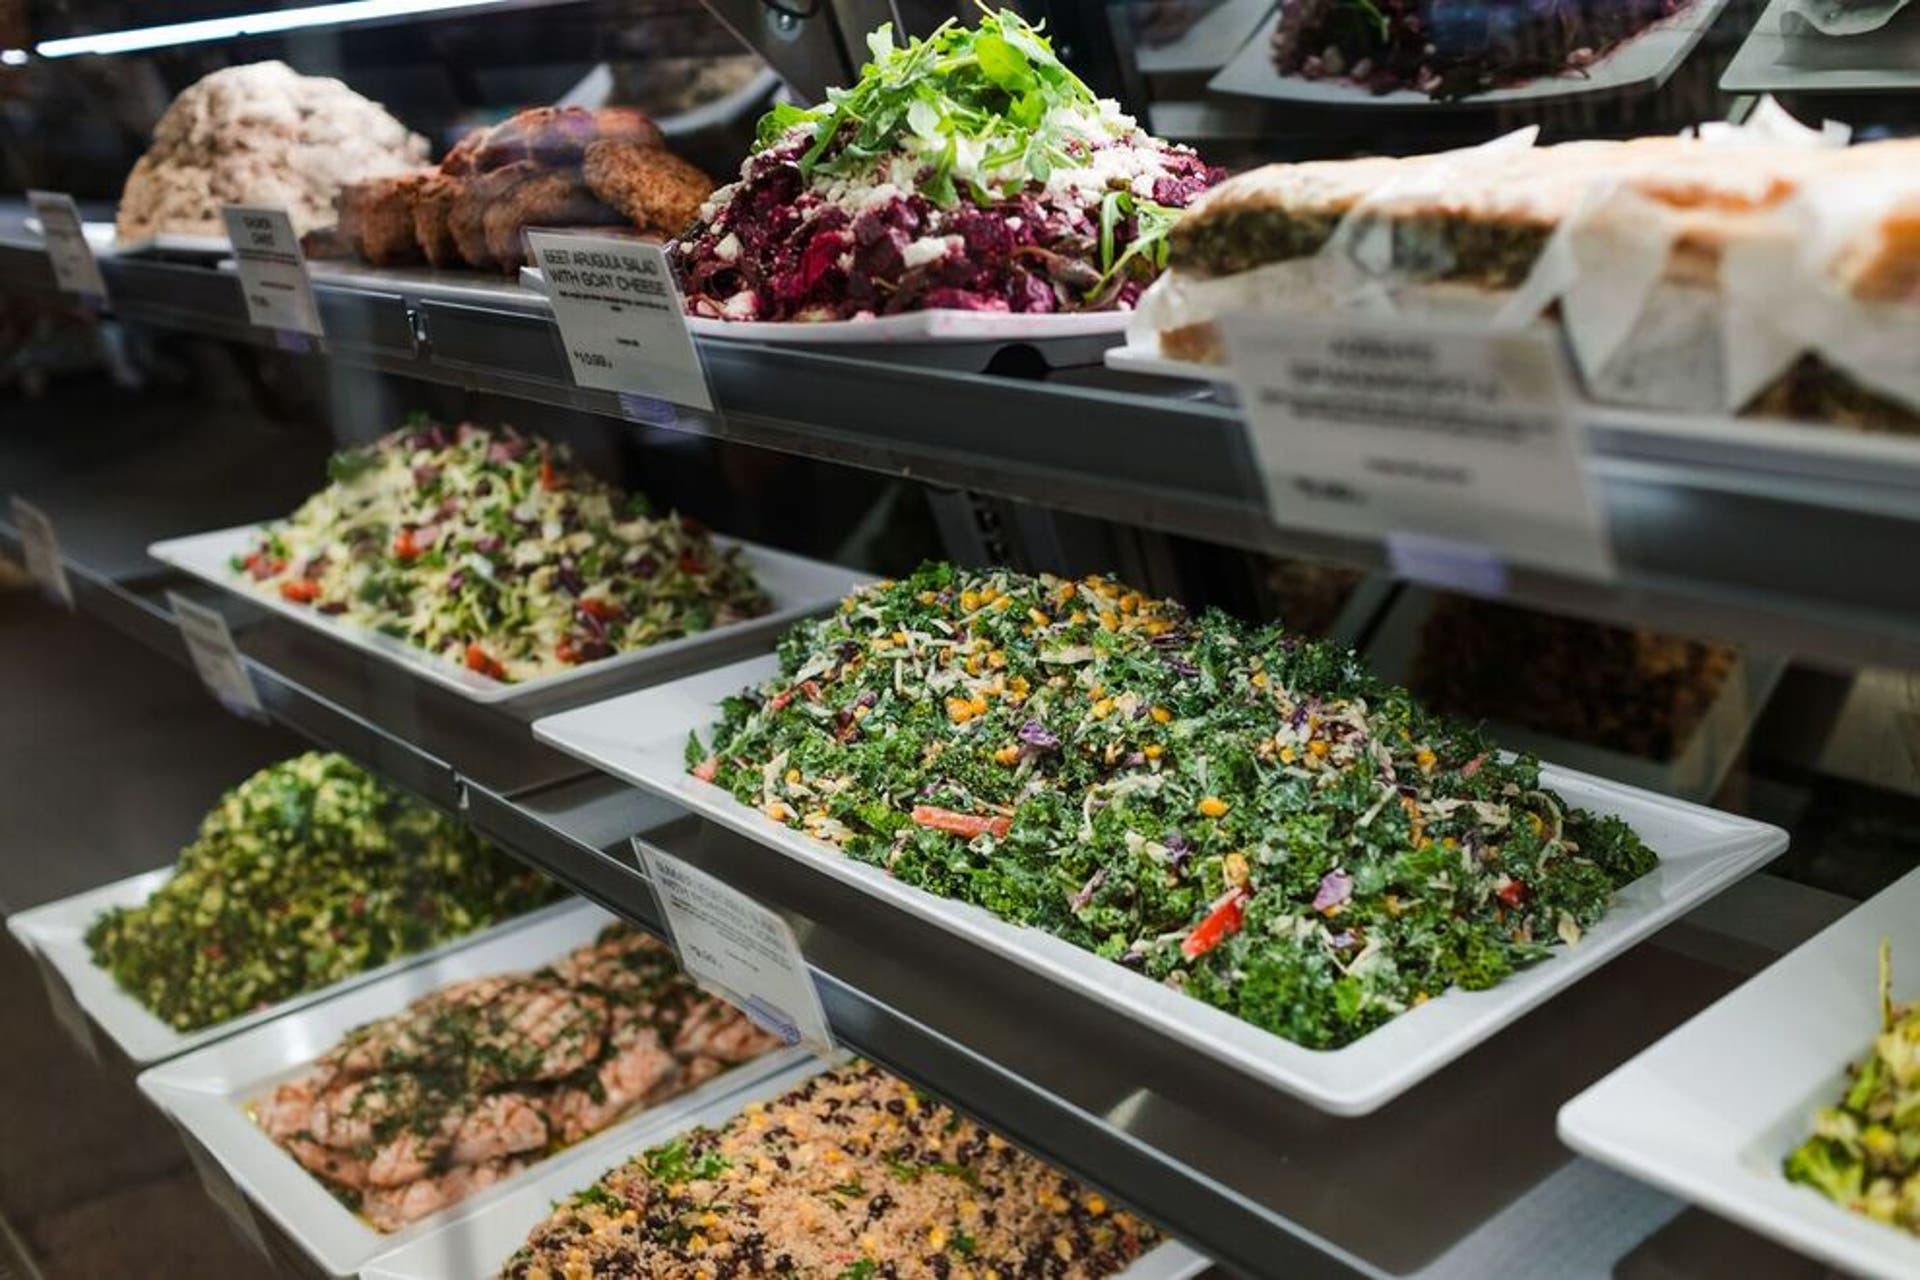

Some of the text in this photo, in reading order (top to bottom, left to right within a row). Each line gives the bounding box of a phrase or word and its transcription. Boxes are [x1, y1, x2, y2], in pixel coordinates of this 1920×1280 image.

[543, 249, 658, 275] BEET ARUGULA SALAD
[549, 269, 667, 297] WITH GOAT CHEESE
